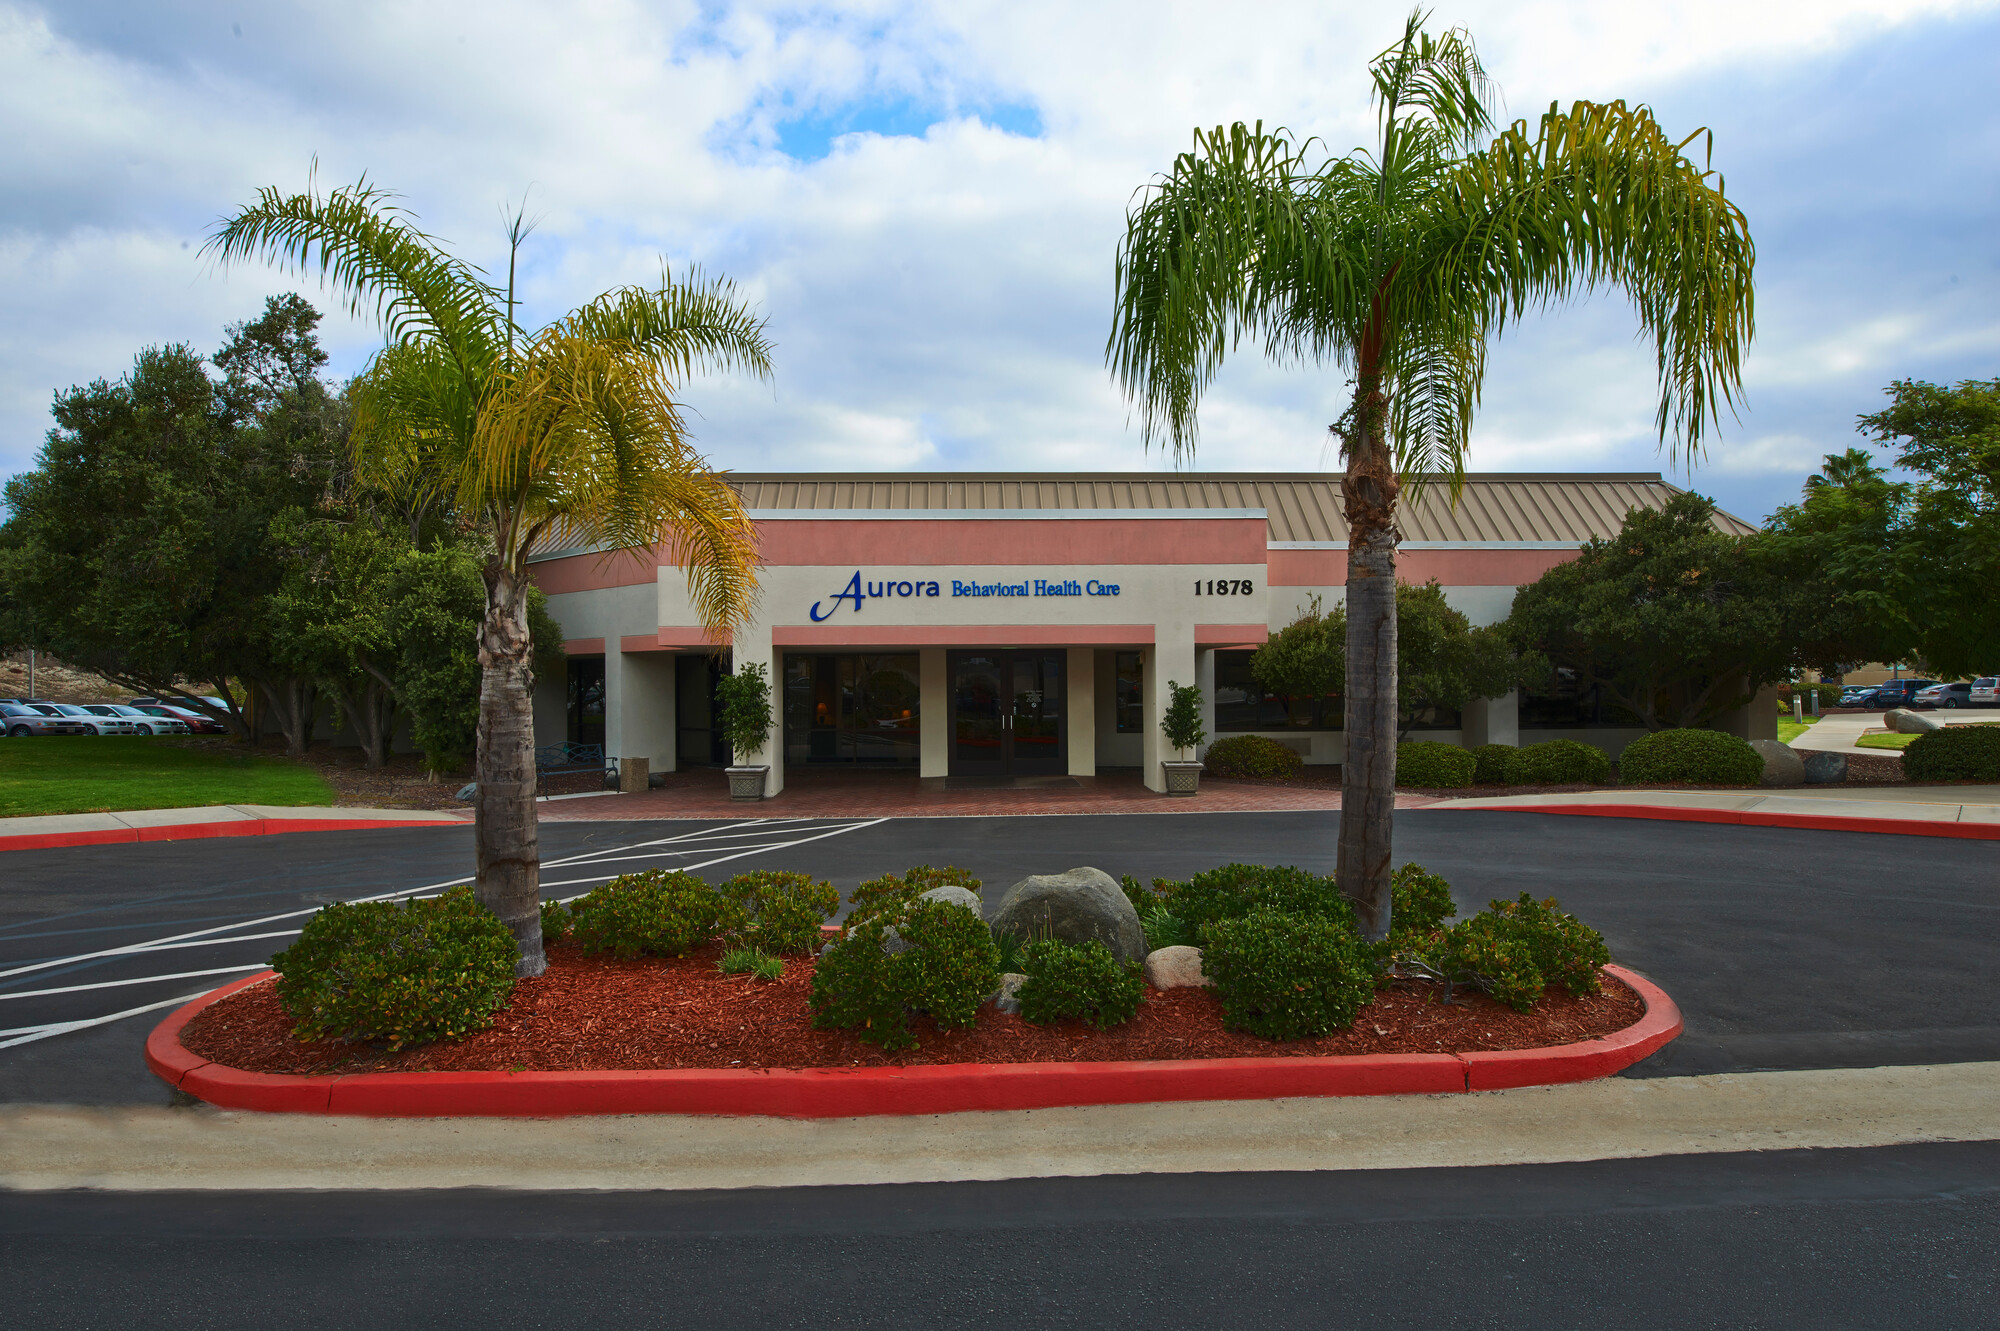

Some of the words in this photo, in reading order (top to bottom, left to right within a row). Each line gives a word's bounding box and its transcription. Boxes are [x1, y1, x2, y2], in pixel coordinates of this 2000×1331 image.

[810, 569, 940, 623] Aurora
[951, 579, 1030, 597] Behavioral
[1034, 579, 1083, 597] Health
[1085, 579, 1121, 597] Care
[1194, 579, 1254, 597] 11878
